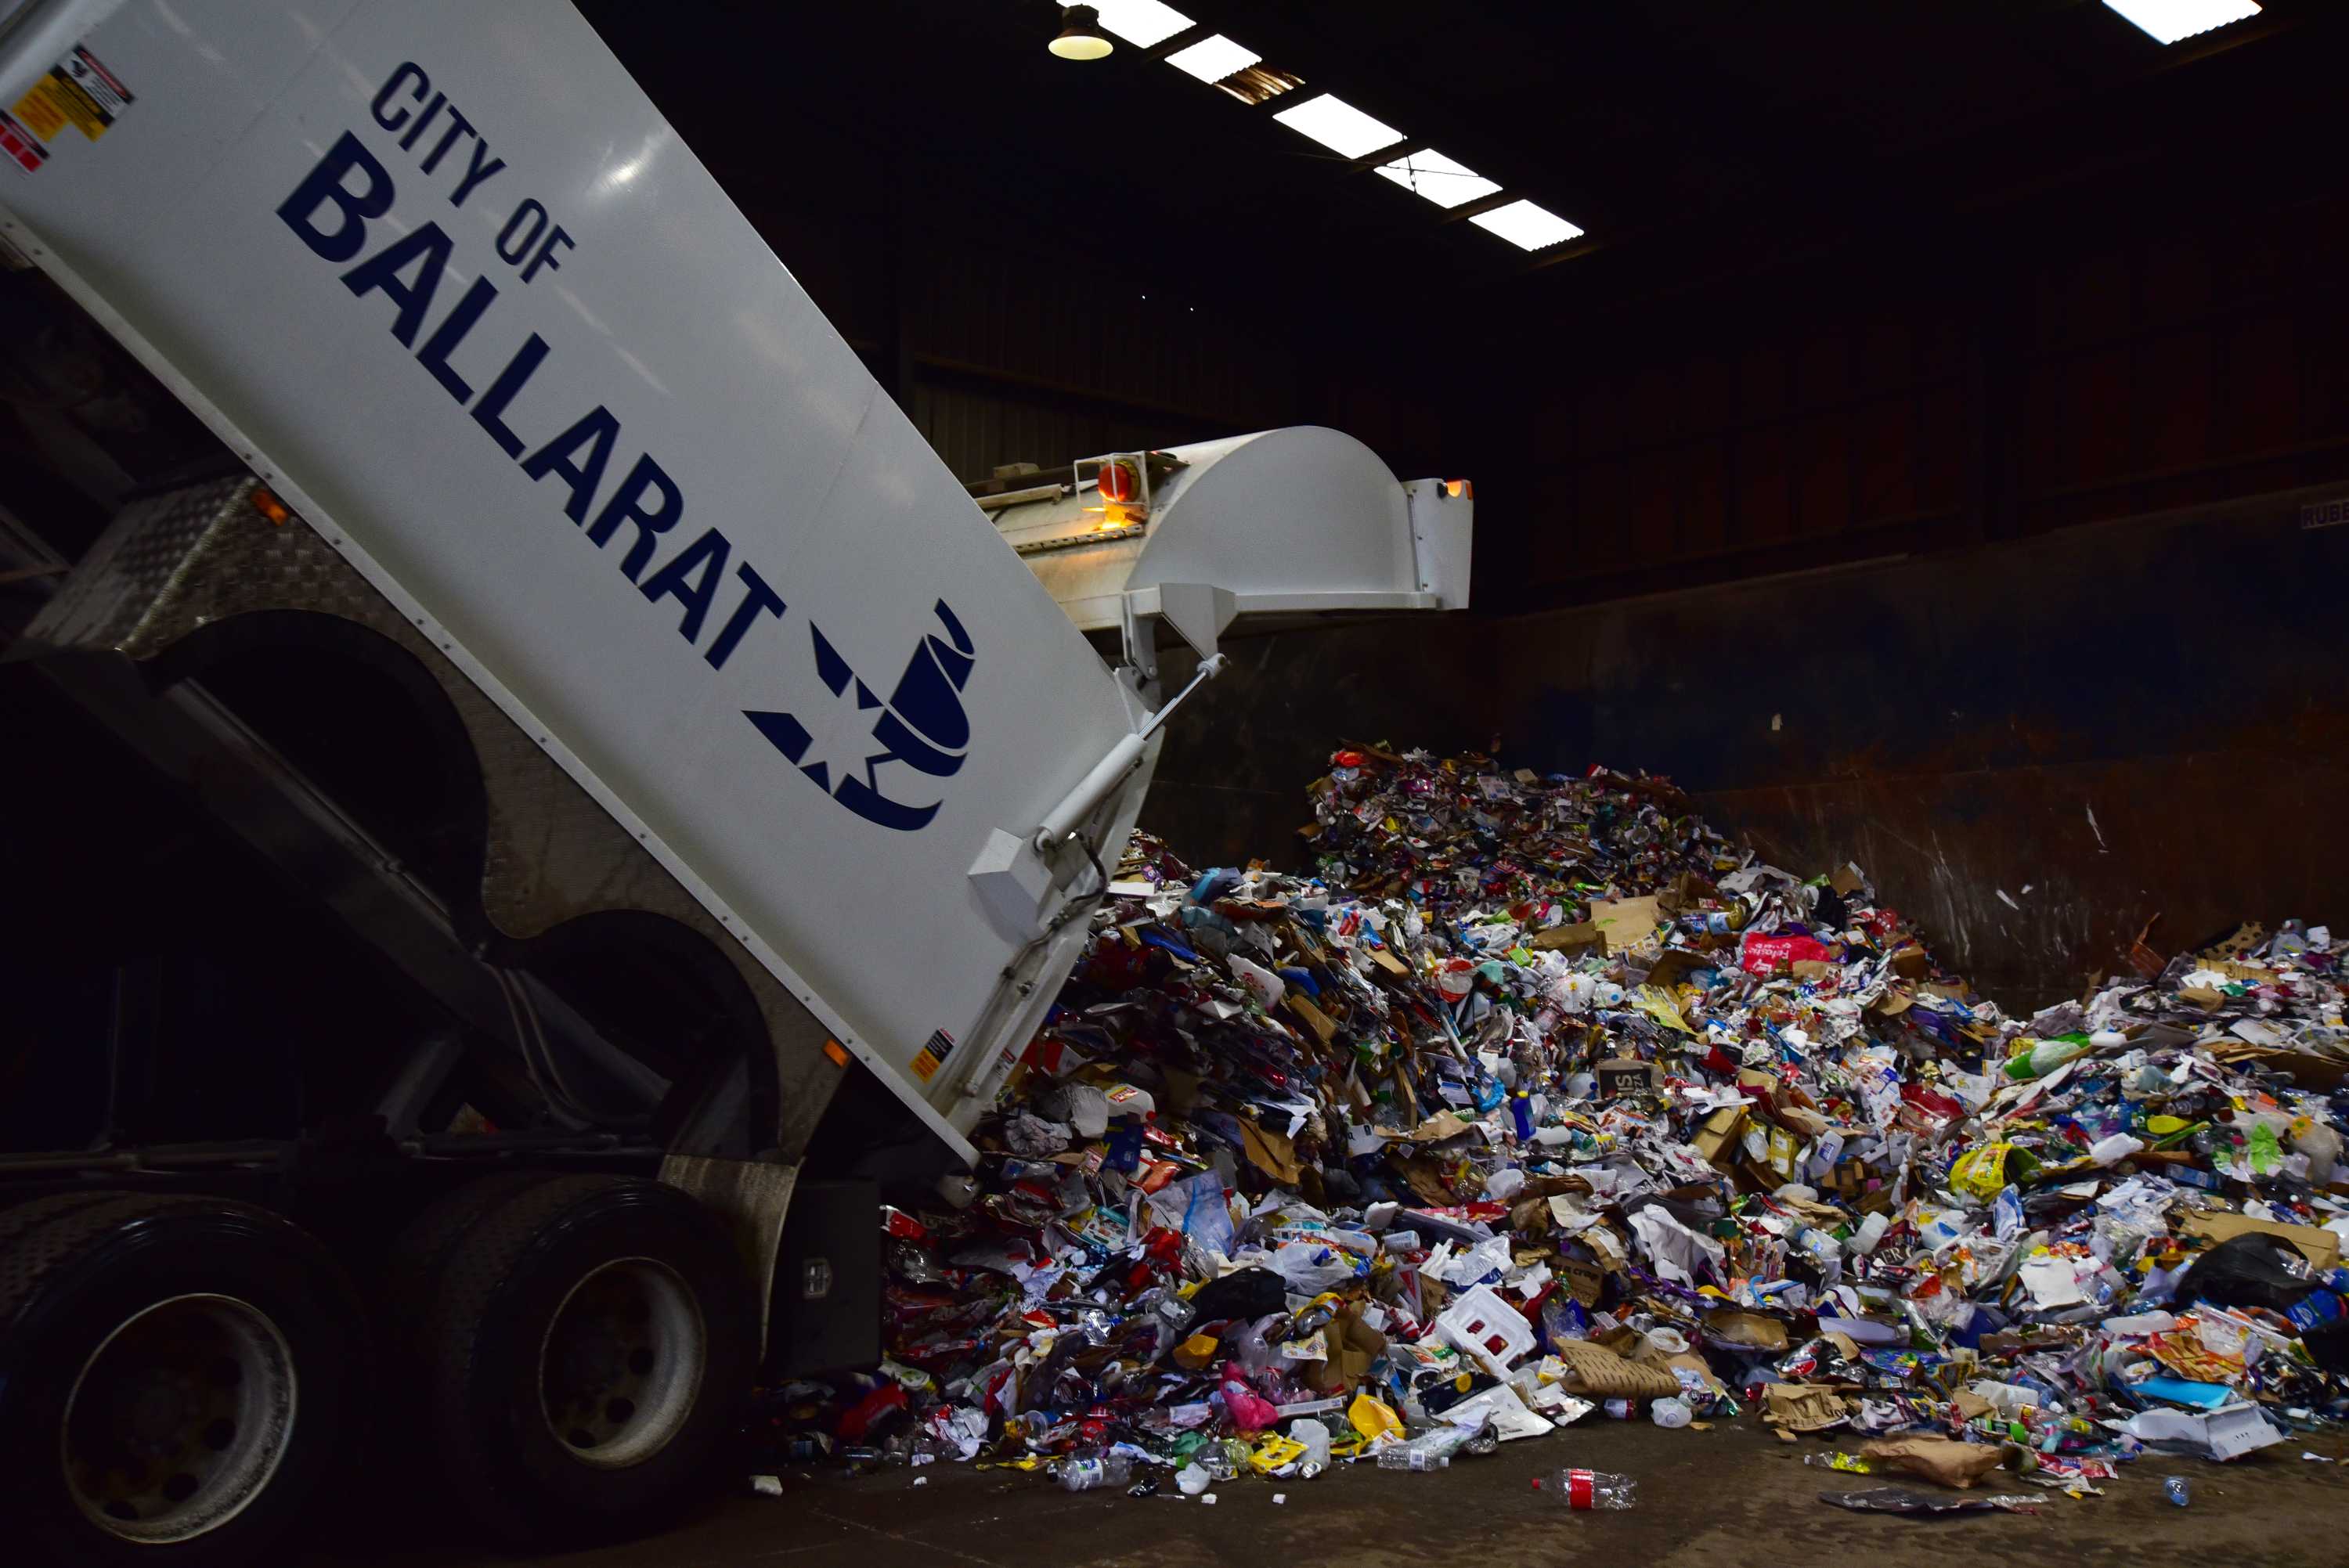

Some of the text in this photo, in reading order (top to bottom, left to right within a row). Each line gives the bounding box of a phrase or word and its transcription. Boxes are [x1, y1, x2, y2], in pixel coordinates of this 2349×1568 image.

[370, 61, 576, 283] CITY OF
[276, 130, 787, 671] BALLARAT
